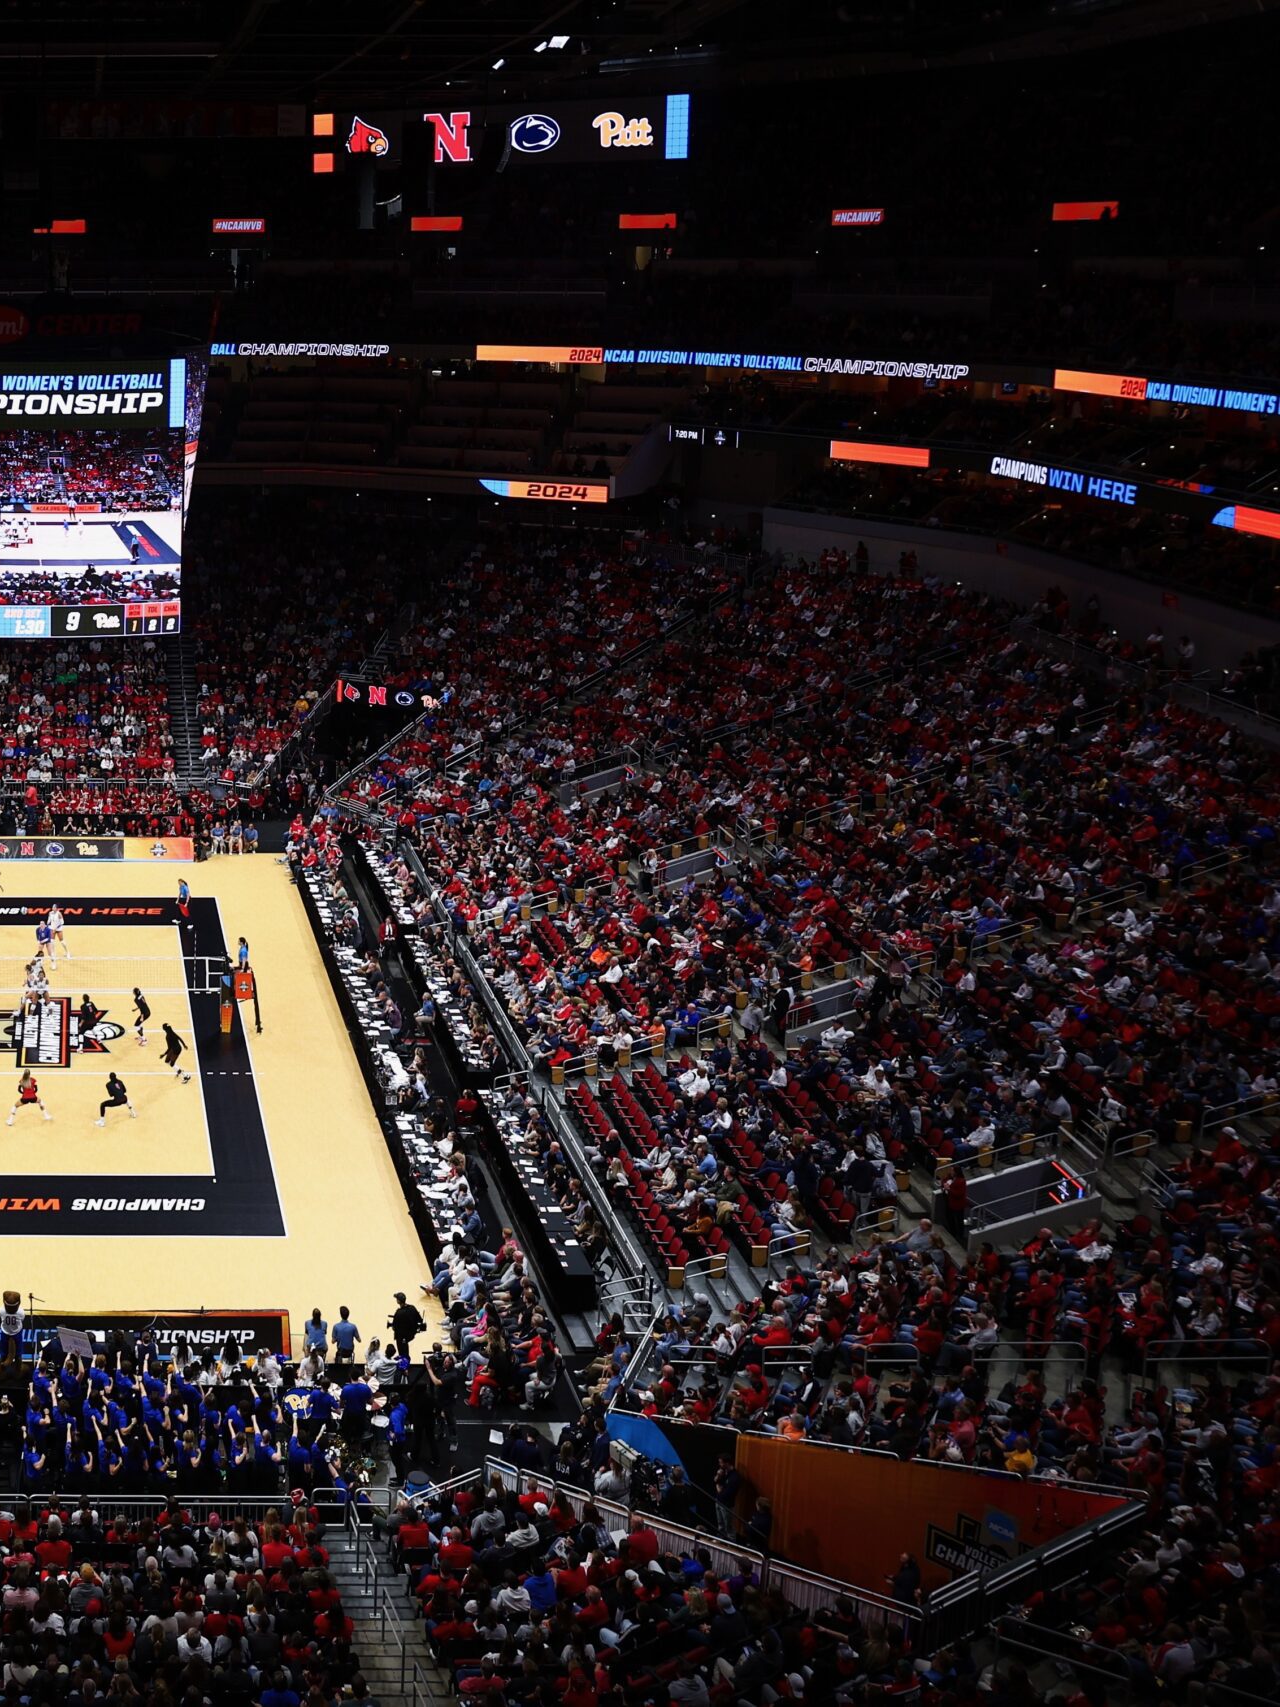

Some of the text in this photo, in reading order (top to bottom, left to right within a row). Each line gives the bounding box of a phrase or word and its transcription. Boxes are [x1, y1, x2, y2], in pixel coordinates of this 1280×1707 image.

[424, 112, 471, 162] N
[592, 111, 654, 148] Pitt
[215, 220, 263, 231] #NCAAWVB
[238, 343, 390, 357] CHAMPIONSHIP
[569, 349, 602, 362] 2024
[603, 349, 635, 363] NCAA
[637, 350, 688, 365] DIVISION
[695, 352, 741, 368] WOMEN'S
[742, 354, 802, 371] VOLLEYBALL
[803, 357, 969, 380] CHAMPIONSHIP
[2, 375, 75, 391] WOMEN'S
[77, 373, 163, 391] VOLLEYBALL
[1121, 378, 1146, 399] 2024
[1145, 381, 1172, 401] NCAA
[1171, 385, 1216, 407] DIVISION
[1223, 390, 1277, 414] WOMEN'S
[675, 430, 698, 440] 7:20 PM
[990, 456, 1138, 505] CHAMPIONS WIN HERE
[526, 484, 588, 500] 2024
[65, 611, 80, 631] 9
[131, 619, 138, 632] 1
[368, 686, 387, 705] N
[20, 842, 34, 856] N
[75, 842, 99, 856] Pitt
[90, 907, 164, 915] HERE
[70, 1198, 206, 1211] CHAMPIONS
